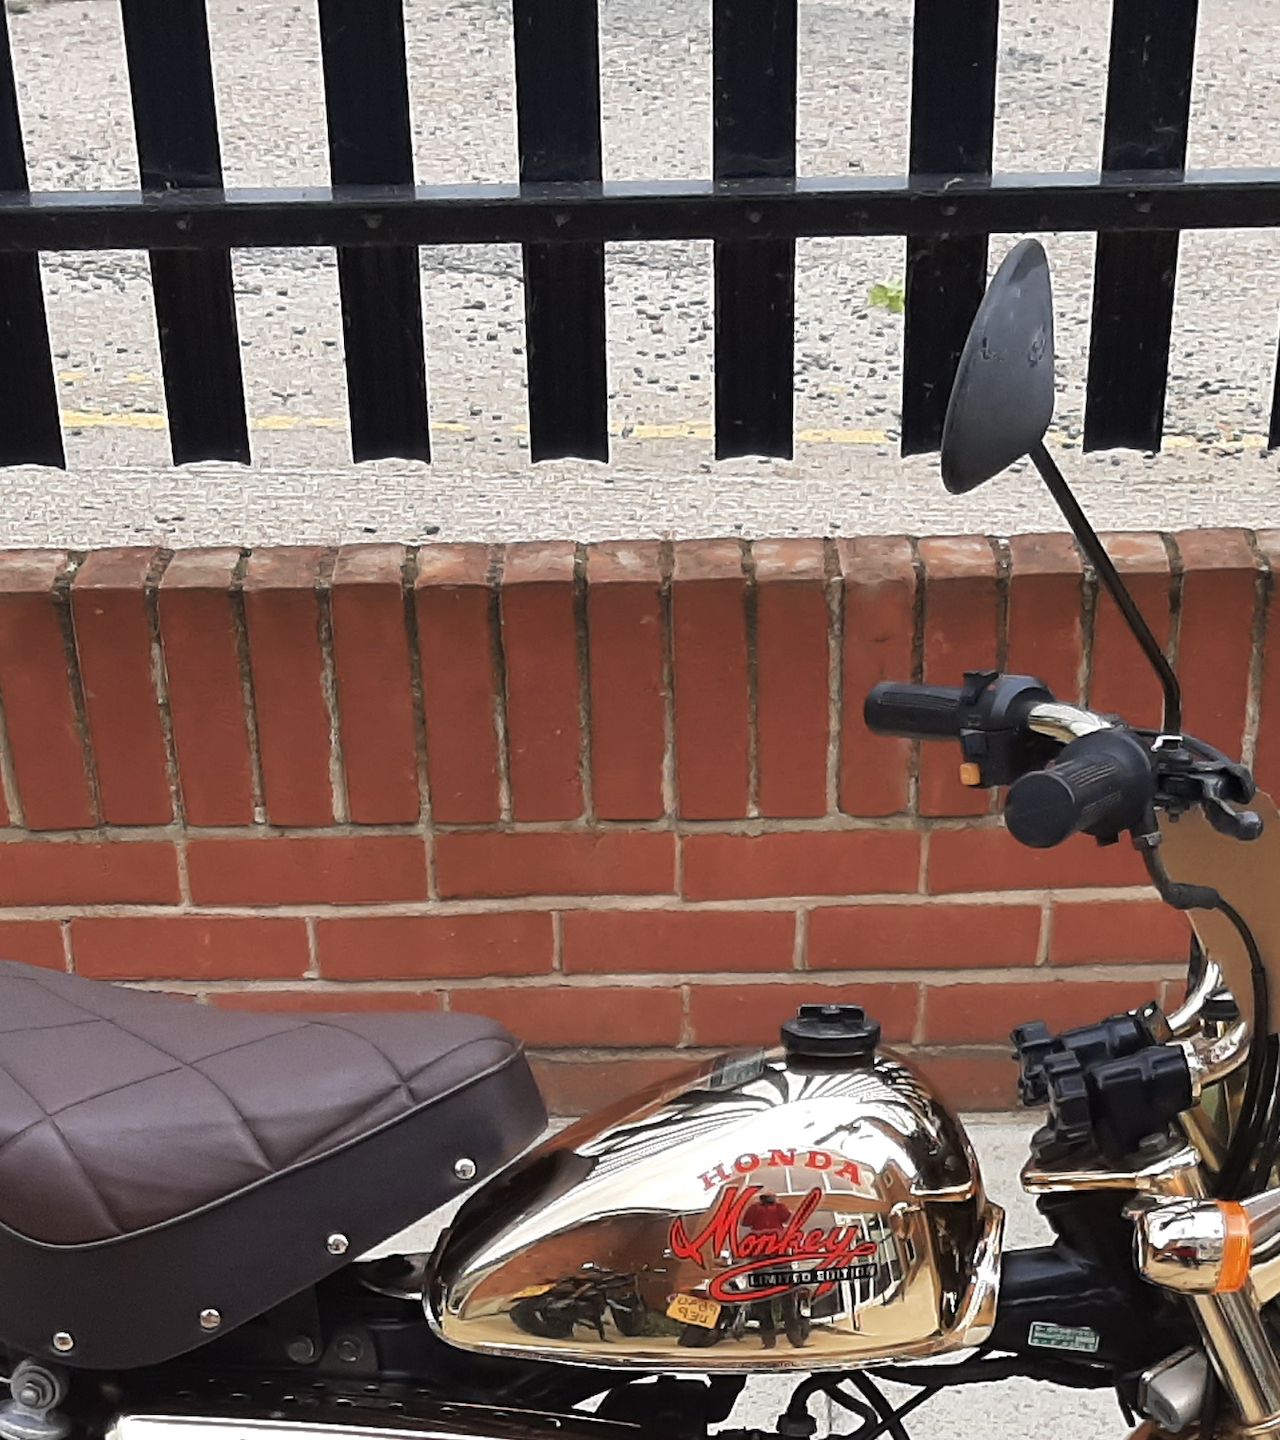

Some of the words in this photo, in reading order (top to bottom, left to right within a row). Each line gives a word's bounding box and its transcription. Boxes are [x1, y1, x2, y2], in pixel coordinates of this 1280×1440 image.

[697, 1148, 862, 1192] HONDA
[671, 1186, 878, 1301] Monkey
[749, 1271, 811, 1287] LIMITED
[816, 1264, 877, 1282] EDITION
